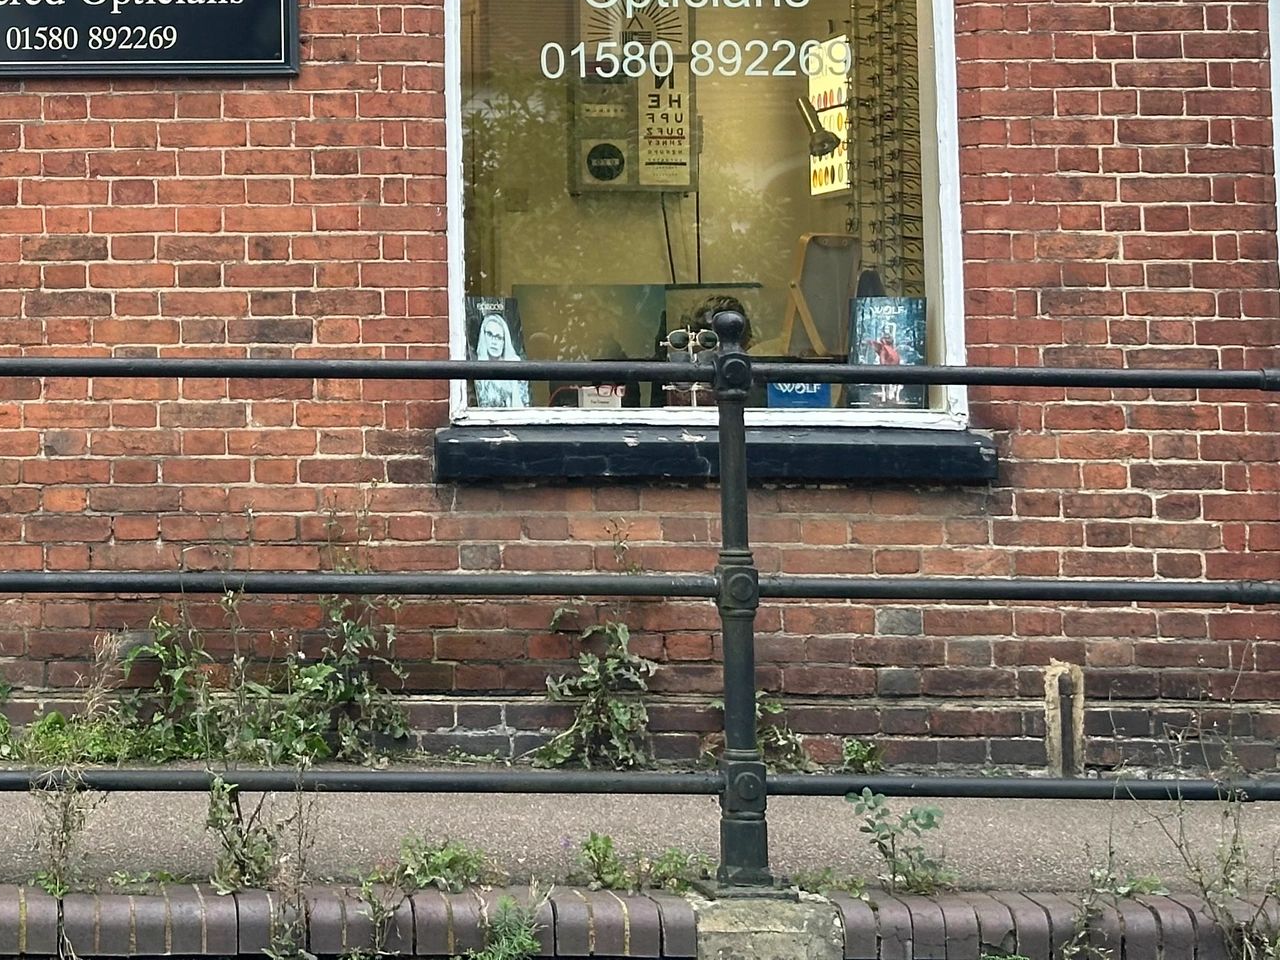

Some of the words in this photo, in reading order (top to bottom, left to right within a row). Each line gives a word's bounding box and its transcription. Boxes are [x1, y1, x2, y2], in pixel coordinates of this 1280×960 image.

[6, 26, 78, 51] 01580
[88, 25, 178, 50] 892269
[540, 40, 674, 79] 01580
[690, 39, 852, 77] 892269
